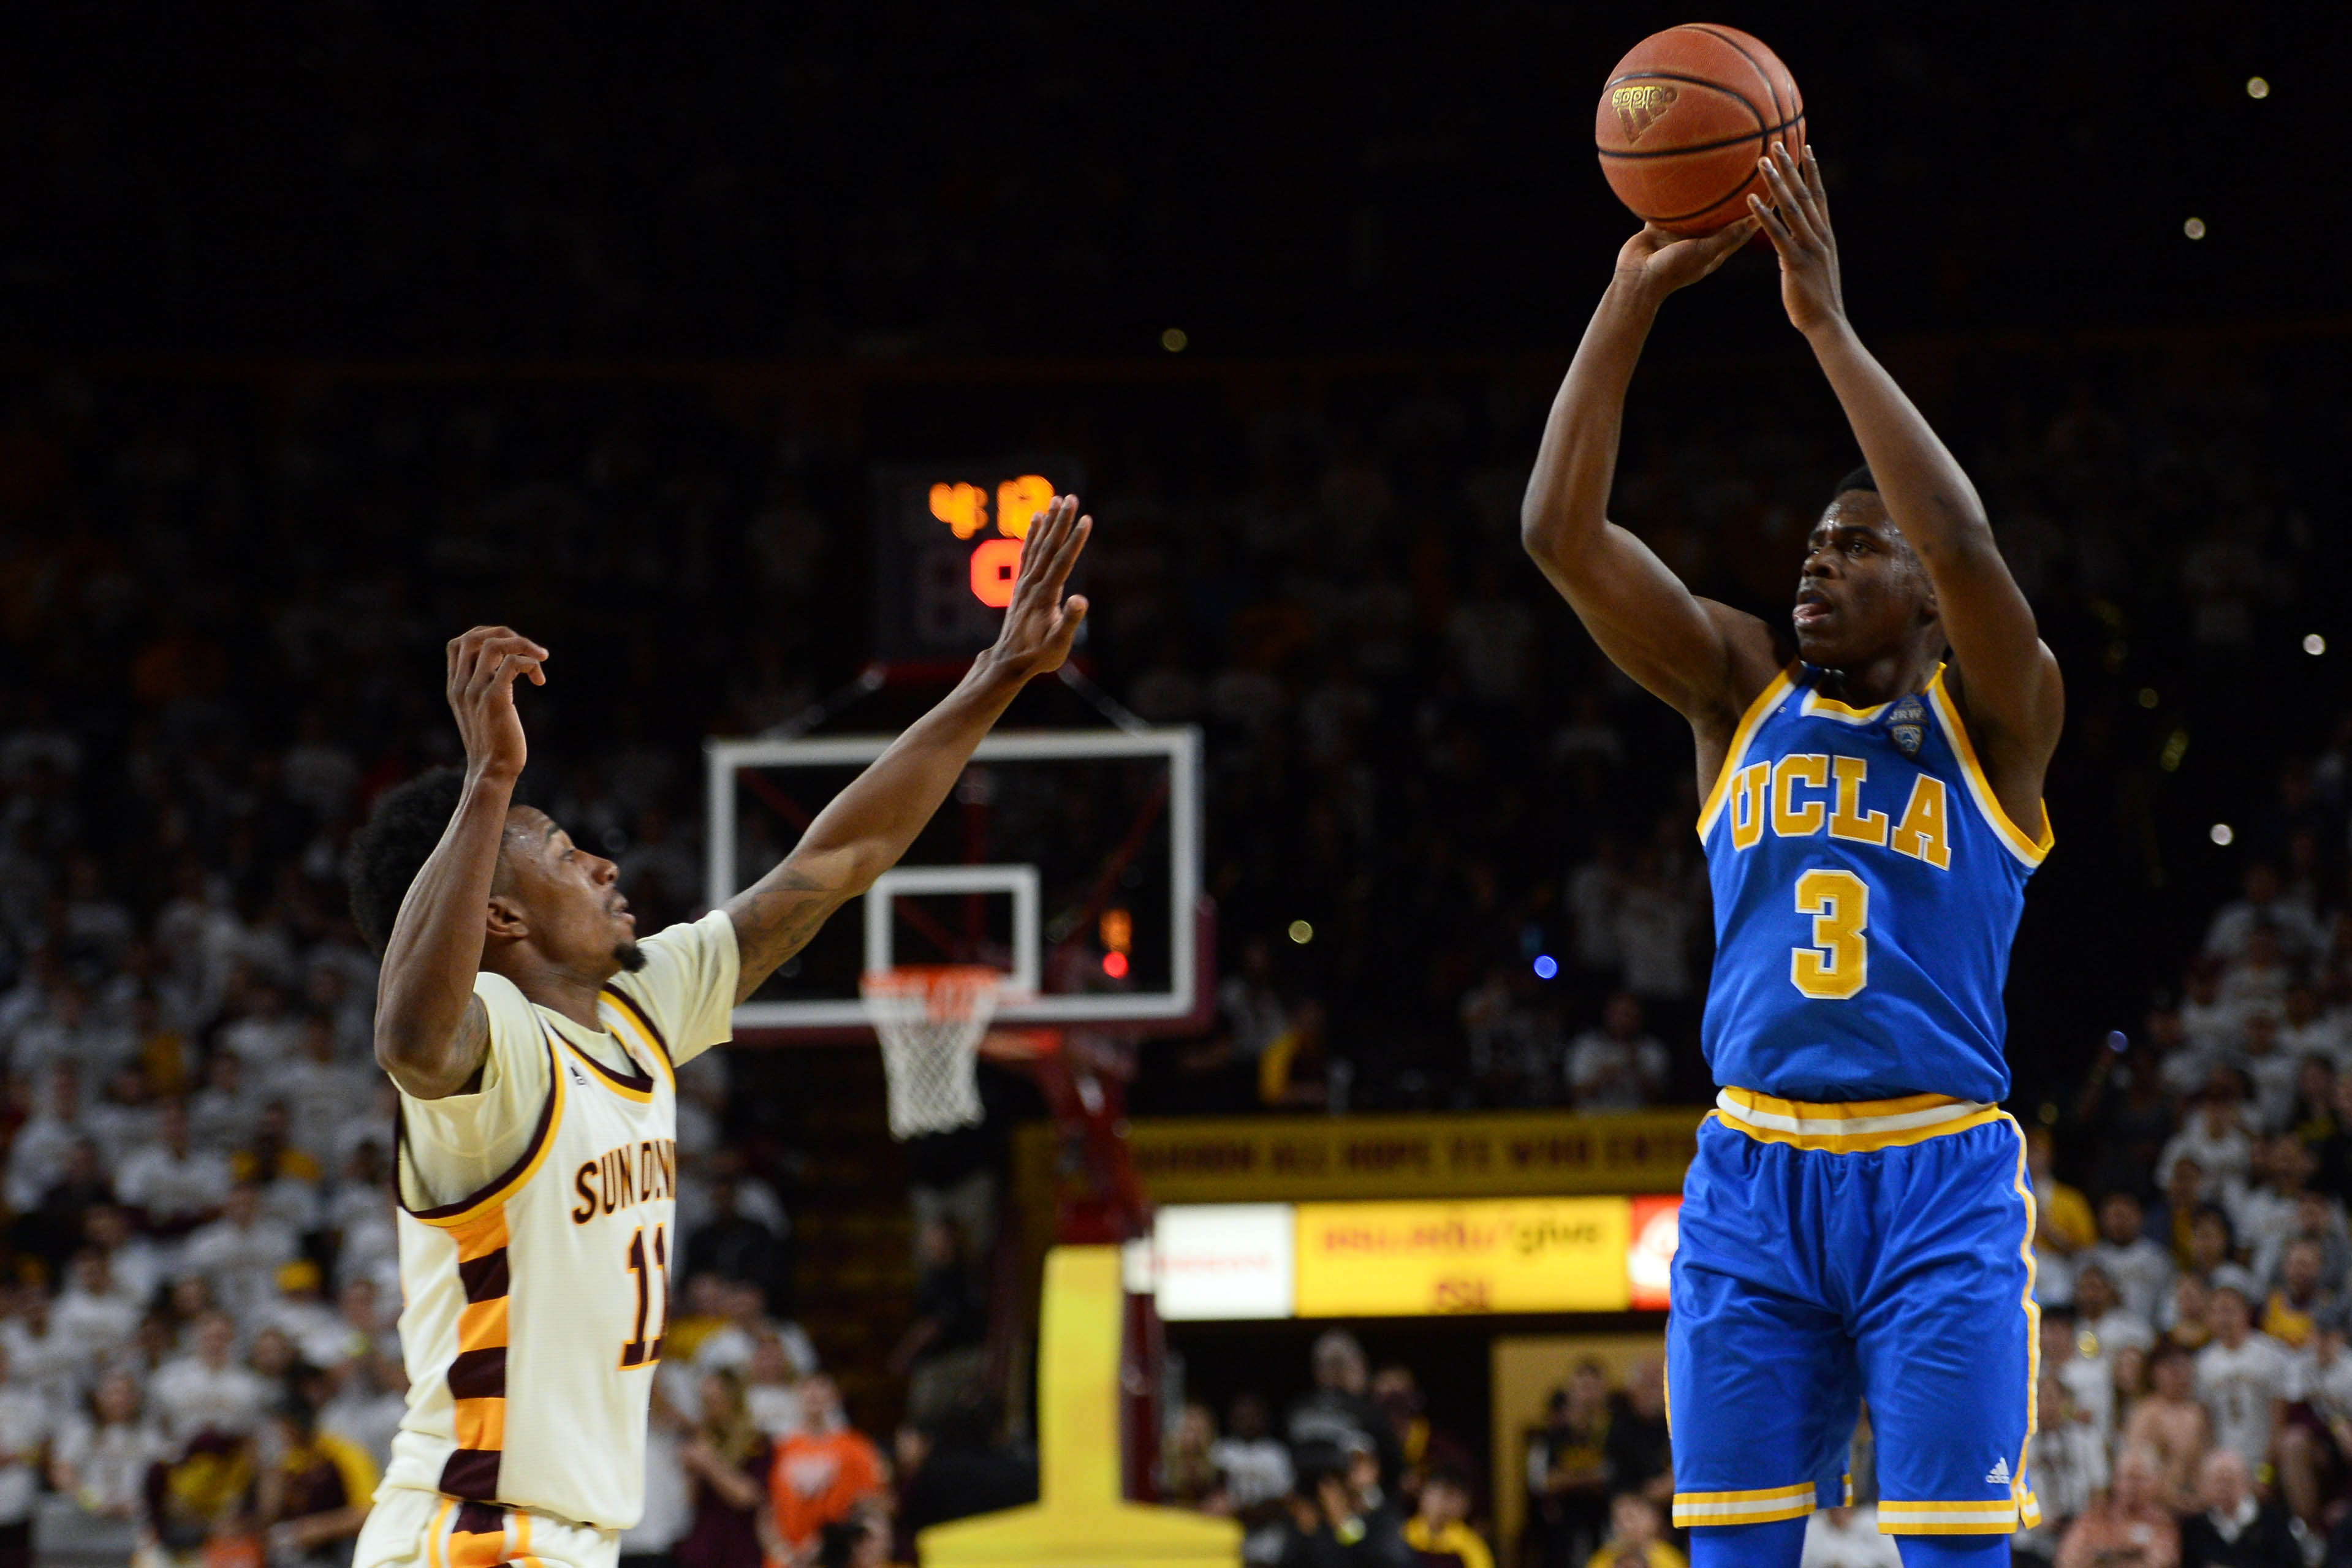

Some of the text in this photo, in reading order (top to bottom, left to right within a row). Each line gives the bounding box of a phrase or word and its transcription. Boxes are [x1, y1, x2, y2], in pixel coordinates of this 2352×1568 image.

[1612, 86, 1678, 111] adidas
[1729, 754, 1952, 872] UCLA
[1790, 869, 1870, 999] 3
[572, 1143, 635, 1225] SUN
[616, 1222, 666, 1371] 11
